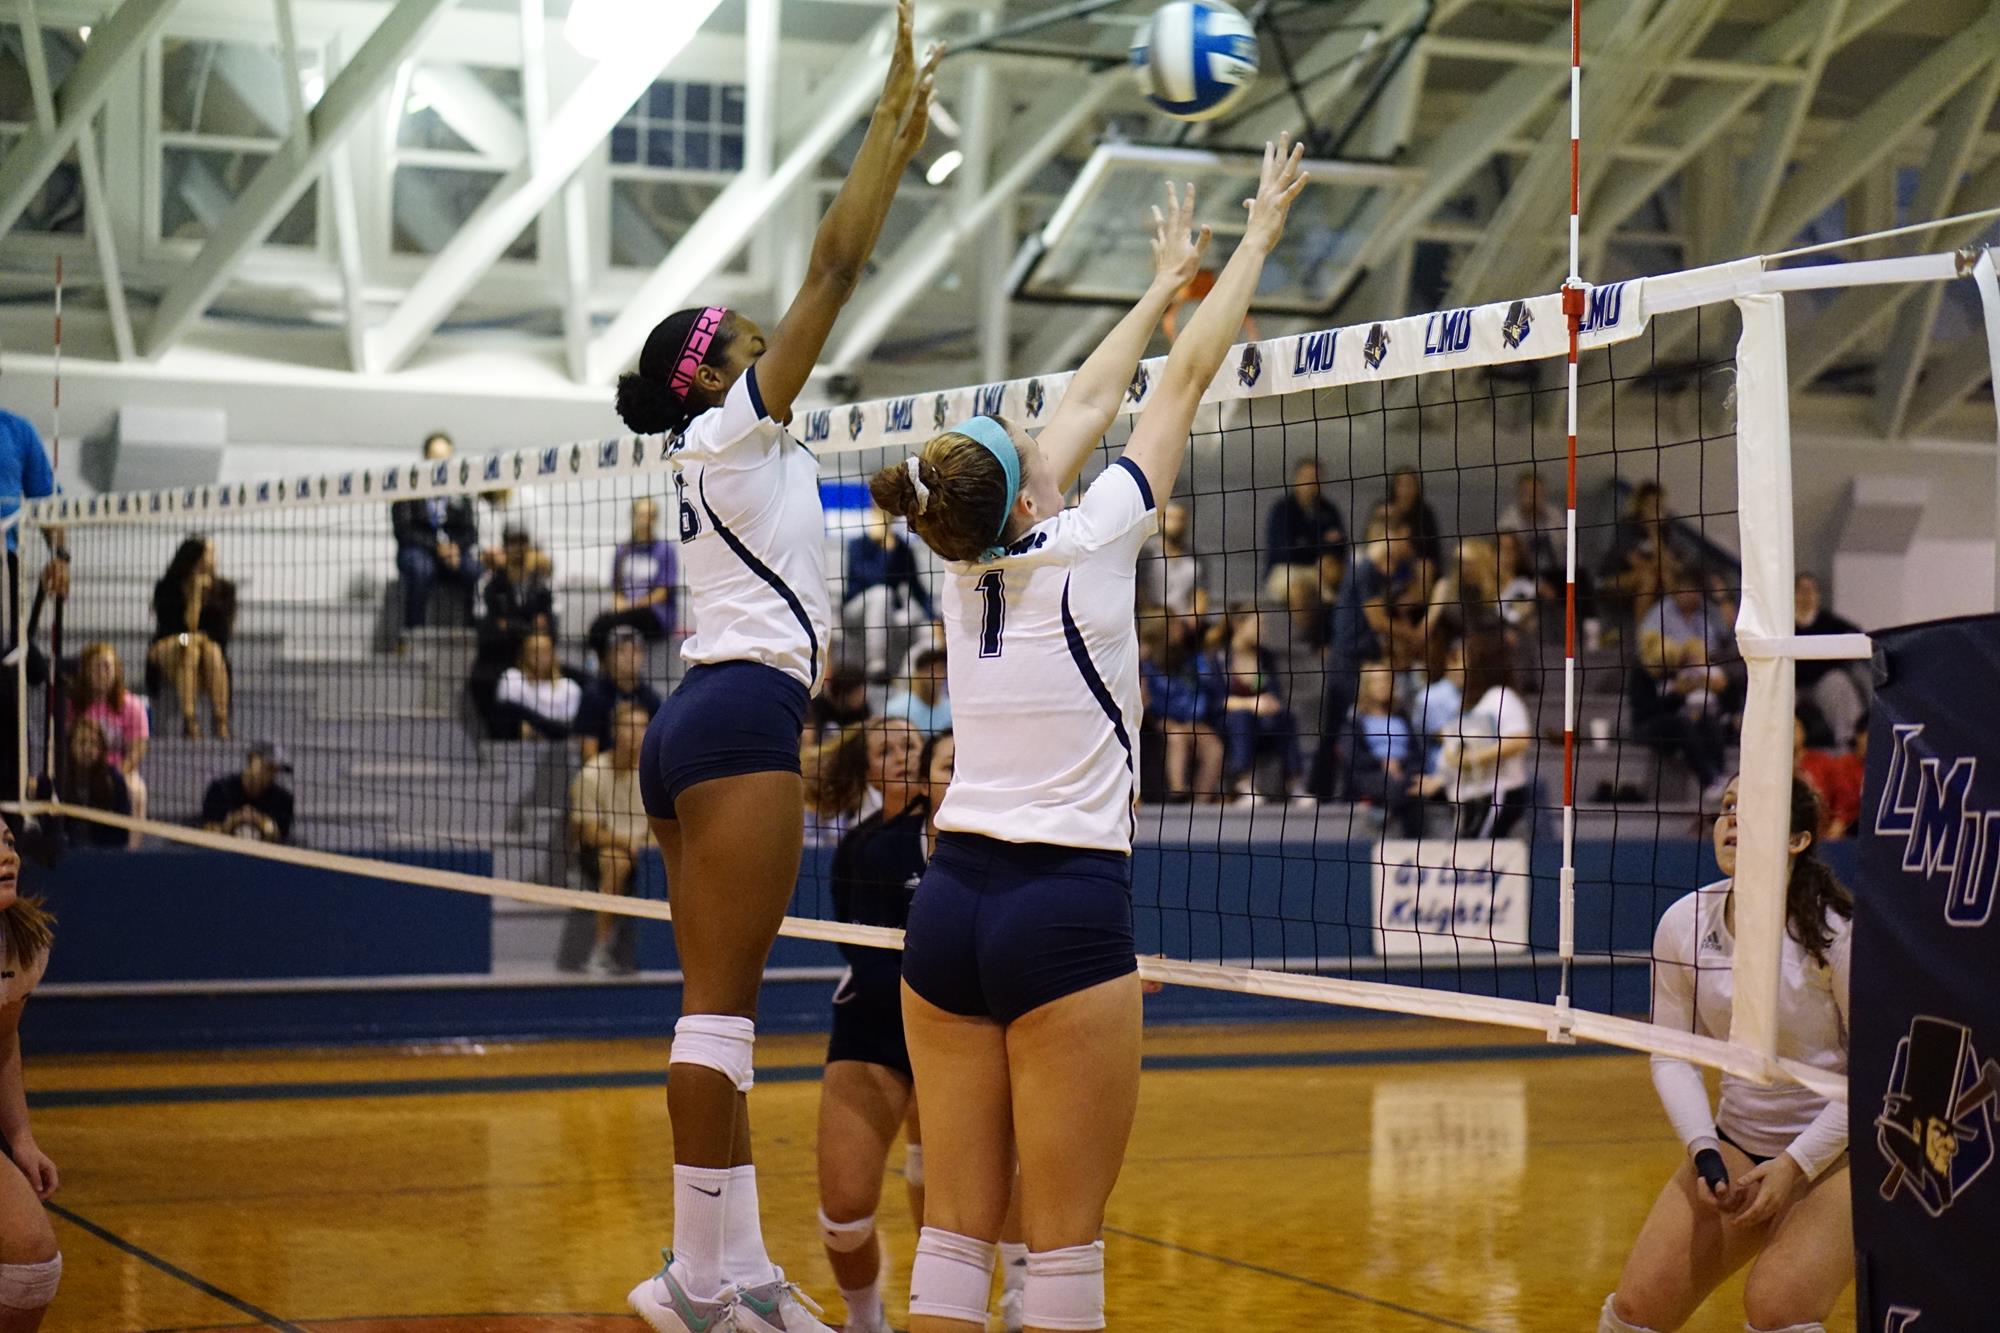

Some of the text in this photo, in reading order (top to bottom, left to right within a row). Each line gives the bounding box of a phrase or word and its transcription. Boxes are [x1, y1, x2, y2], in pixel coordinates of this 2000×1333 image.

[1293, 330, 1342, 378] LMU
[1424, 308, 1474, 359] LMU
[885, 399, 914, 433] LMU
[973, 384, 1006, 417] LMU
[804, 410, 832, 442] LMU
[974, 569, 1006, 658] 1
[1875, 724, 2000, 927] LMU
